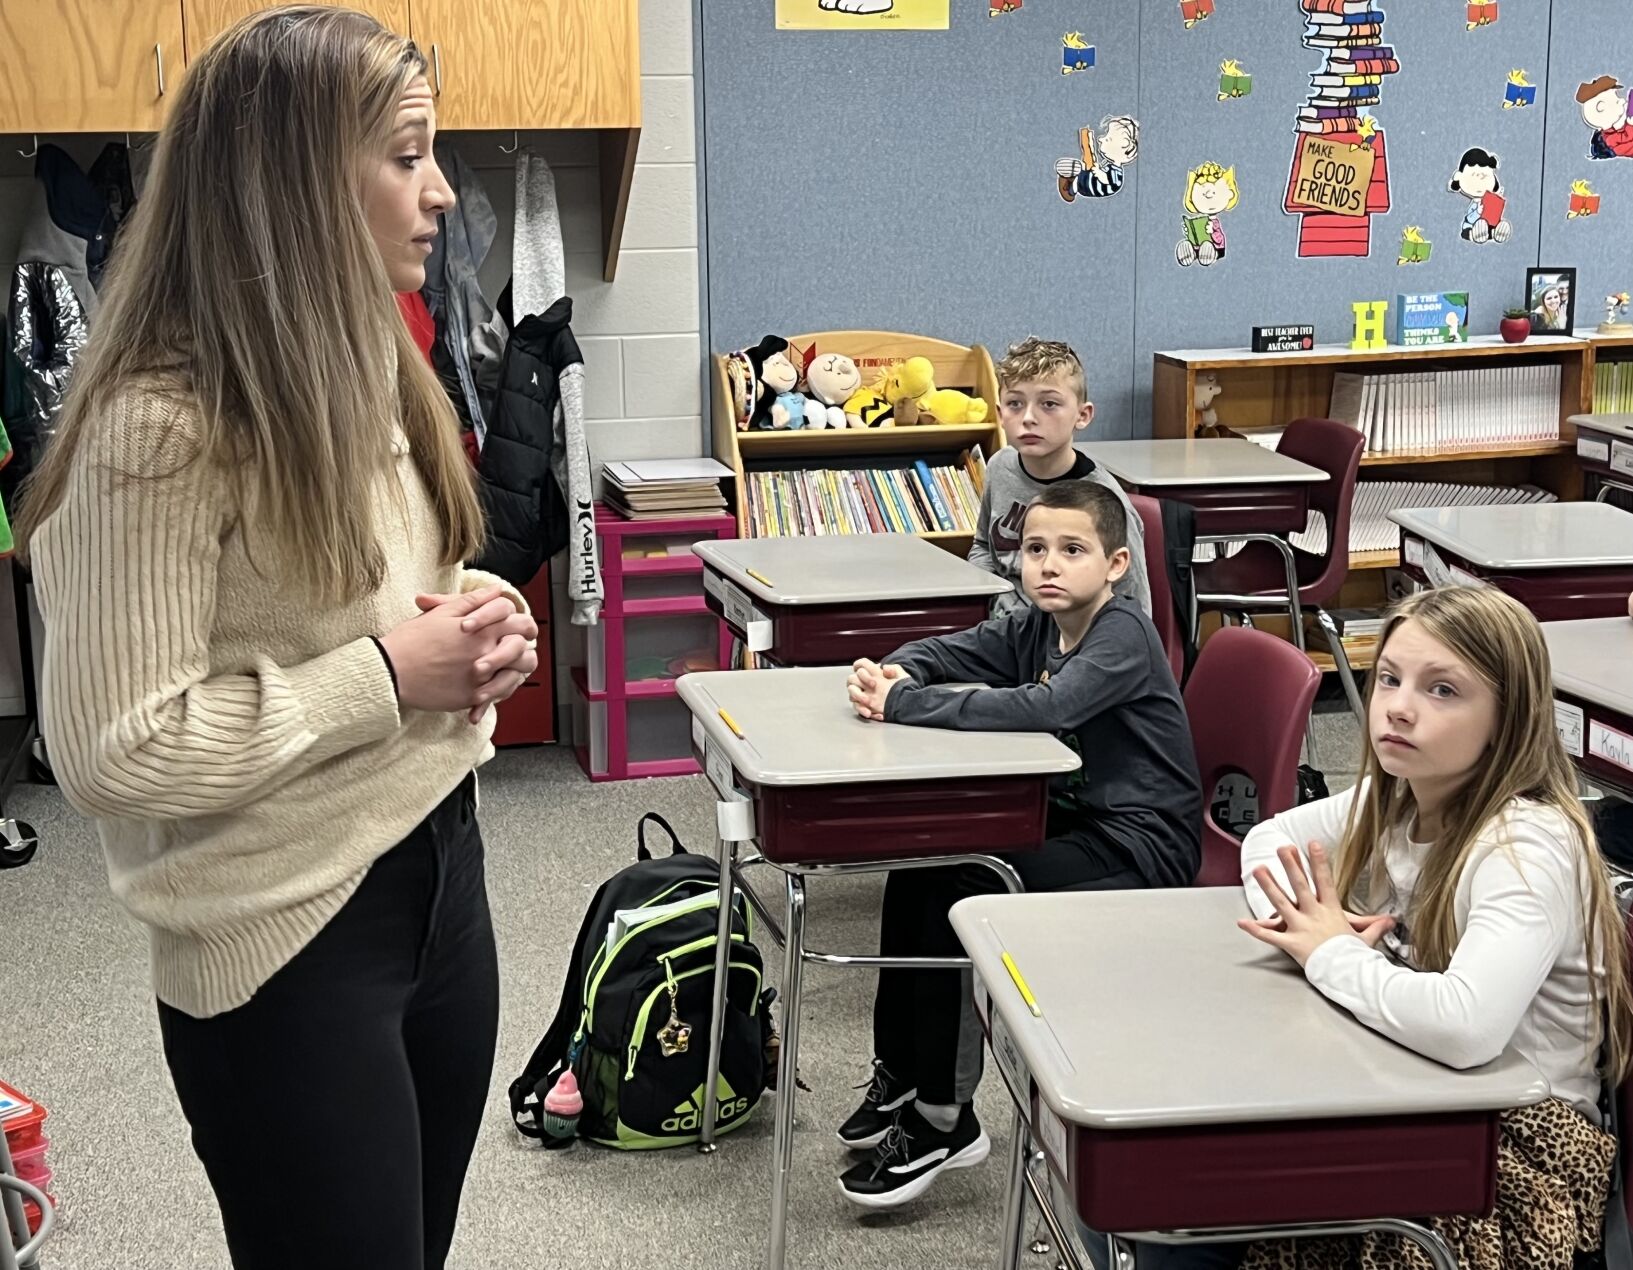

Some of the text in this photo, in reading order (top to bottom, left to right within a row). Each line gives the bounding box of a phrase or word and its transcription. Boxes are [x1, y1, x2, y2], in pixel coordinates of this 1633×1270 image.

[1307, 141, 1335, 159] MAKE
[1313, 159, 1356, 185] GOOD
[1297, 178, 1361, 210] FRIENDS
[1407, 294, 1438, 304] BE THE
[1405, 303, 1442, 313] PERSON
[1275, 327, 1299, 336] TEACHER
[1350, 301, 1389, 350] H
[1404, 327, 1439, 337] THINKS
[1404, 335, 1445, 346] YOU ARE
[580, 523, 597, 595] Hurley
